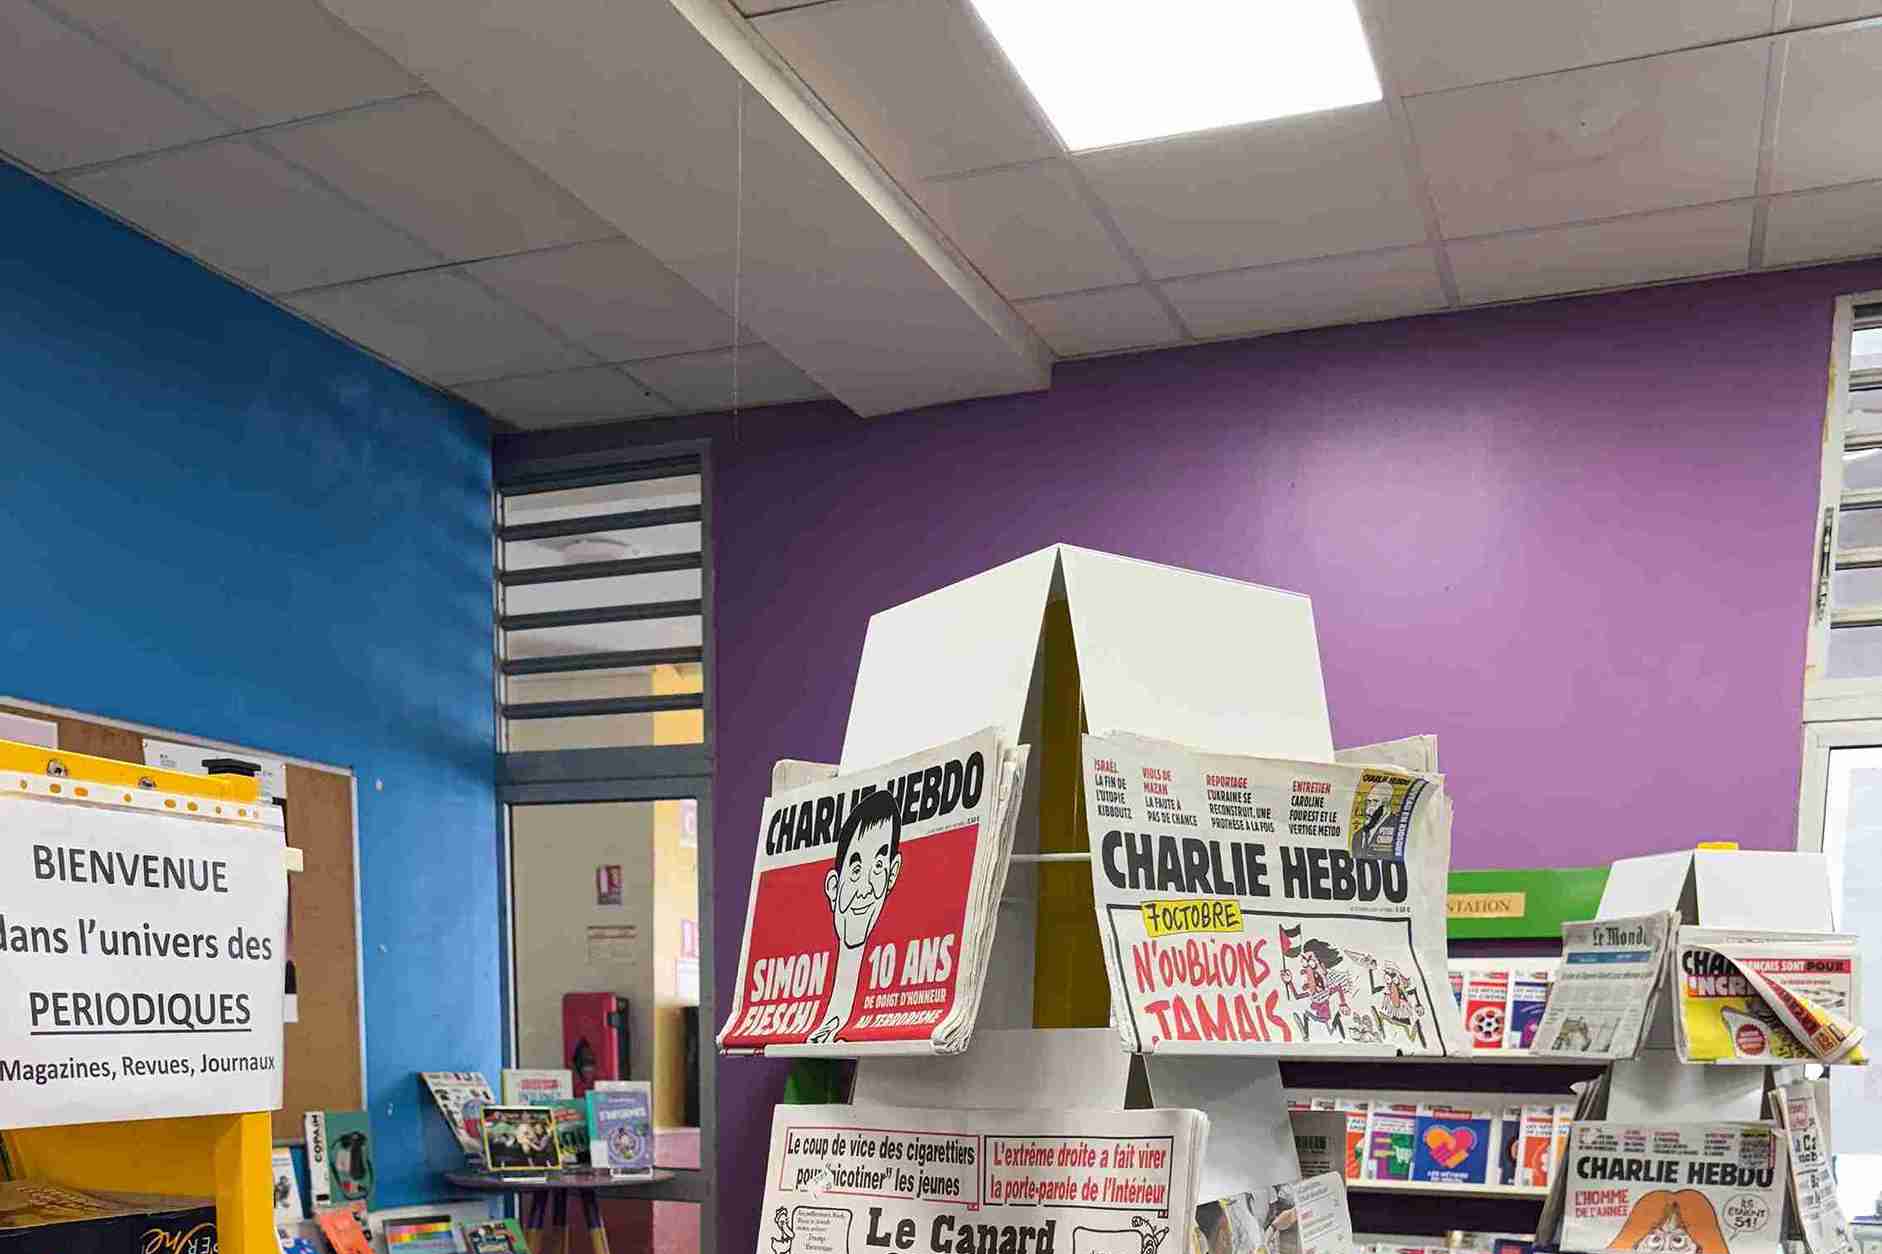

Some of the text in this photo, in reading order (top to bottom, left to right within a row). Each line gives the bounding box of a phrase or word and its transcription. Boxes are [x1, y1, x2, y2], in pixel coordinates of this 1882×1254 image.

[1143, 767, 1162, 781] VIOLS
[1206, 775, 1248, 789] REPORTAGE
[1292, 780, 1331, 794] ENTRETIEN
[766, 751, 984, 855] CHARL HEBDO
[1154, 798, 1175, 811] FAUTE
[1256, 808, 1271, 819] UNE
[1289, 809, 1320, 823] FOUREST
[1291, 795, 1324, 808] CAROLINE
[1147, 810, 1198, 827] PAS CHANCE
[1260, 821, 1275, 833] FOIS
[1288, 823, 1317, 837] VERTIGE
[33, 844, 229, 893] BIENVENUE
[1101, 830, 1408, 903] CHARLIE HEBDO
[78, 918, 219, 960] l'univers
[228, 927, 273, 960] des
[751, 934, 954, 1003] SIMON 10 ANS
[30, 991, 252, 1030] PERIODIQUES
[864, 995, 874, 1009] DE
[0, 1053, 276, 1085] Magazines, Revues, Journaux
[788, 1133, 975, 1166] Le coup de vice des cigarettiers
[993, 1141, 1167, 1170] L'extrême droite a fait virer
[895, 1167, 914, 1193] les
[917, 1170, 961, 1198] jeunes
[1577, 1156, 1775, 1188] CHARLIE HEBDO
[990, 1174, 1001, 1199] la
[1004, 1175, 1077, 1205] porte-parole
[1081, 1176, 1098, 1201] de
[1575, 1188, 1630, 1206] L'HOMME
[866, 1207, 916, 1250] Le
